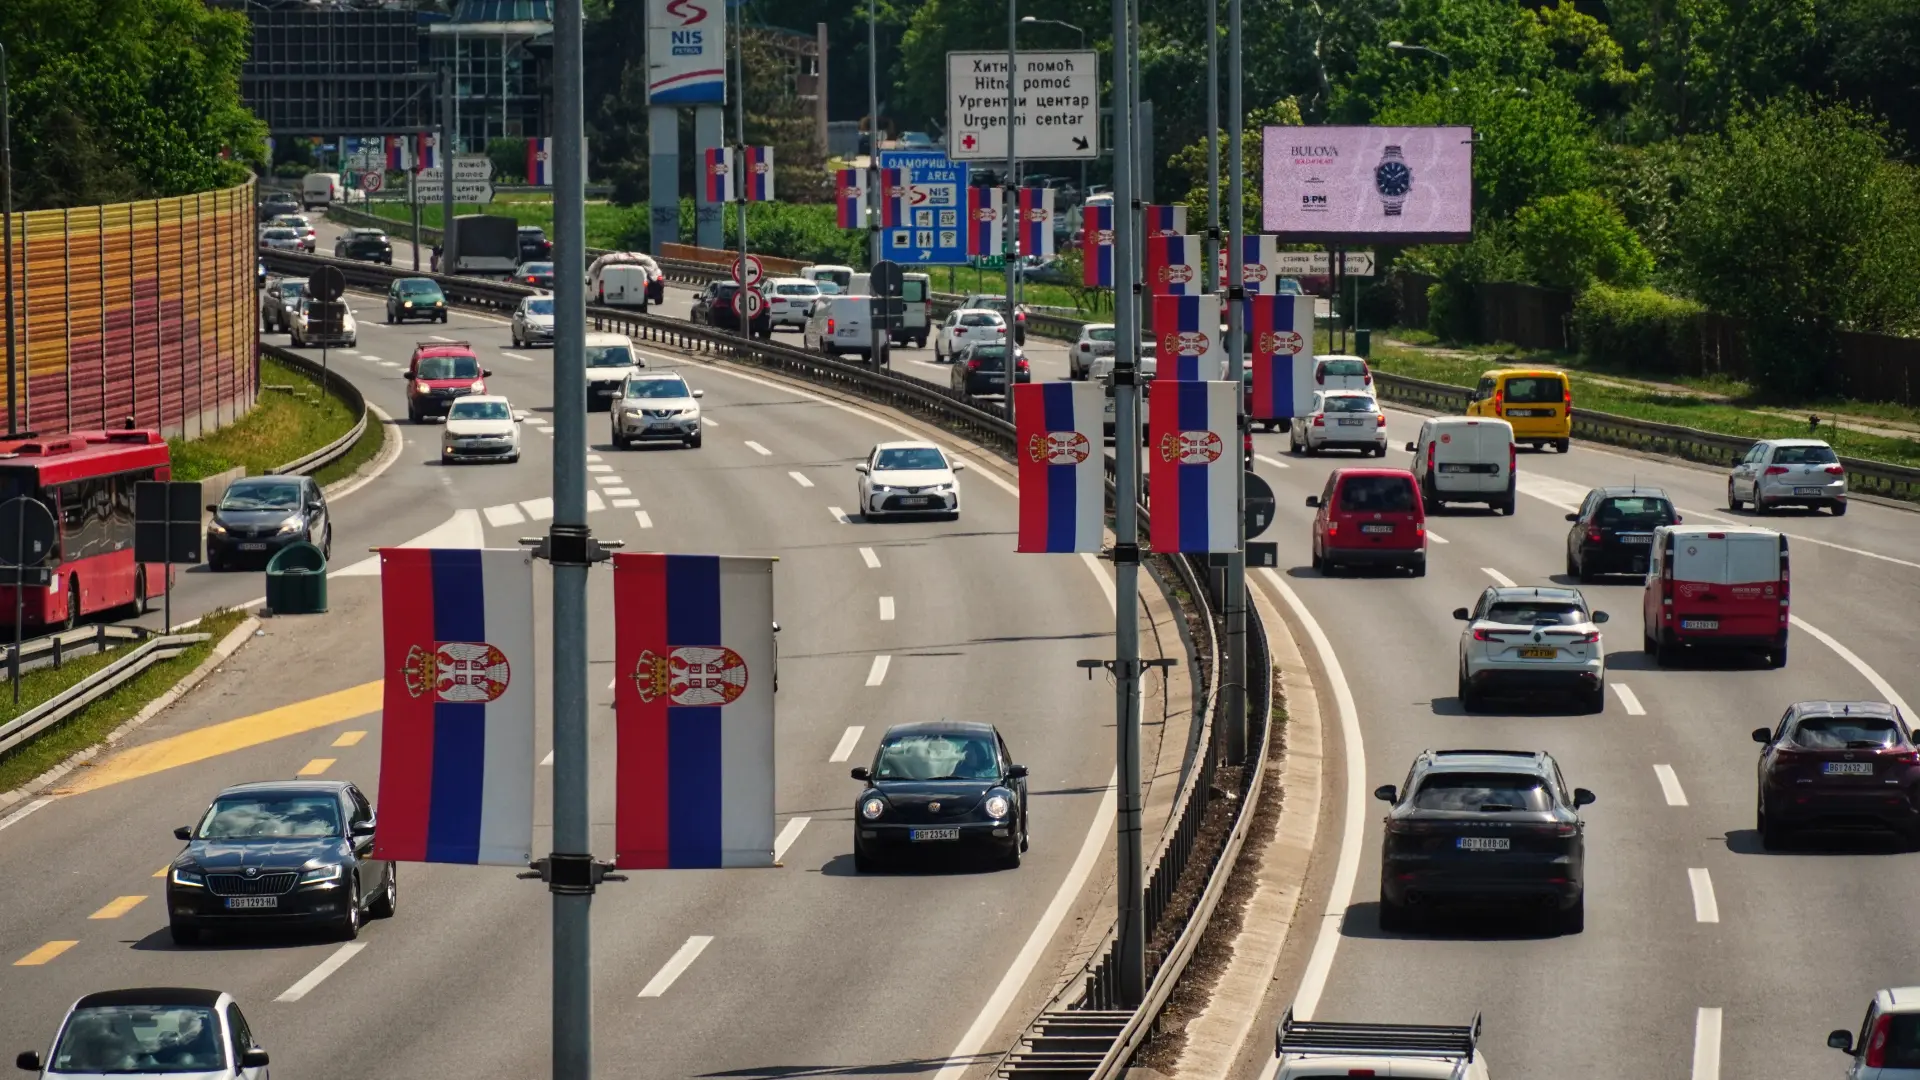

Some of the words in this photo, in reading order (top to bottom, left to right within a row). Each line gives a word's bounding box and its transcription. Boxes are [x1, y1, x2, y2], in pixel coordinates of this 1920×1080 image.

[672, 31, 702, 44] NIS
[1028, 58, 1074, 72] помоћ
[1023, 76, 1071, 92] pomoć
[1036, 95, 1089, 108] центар
[963, 113, 1026, 130] Urgenni
[1035, 112, 1084, 126] centar
[1291, 146, 1338, 156] BULOVA
[927, 171, 956, 181] AREA
[929, 187, 949, 197] NIS
[1830, 763, 1839, 772] BG
[915, 830, 925, 840] BG
[1462, 838, 1472, 848] BG
[231, 898, 240, 908] BG
